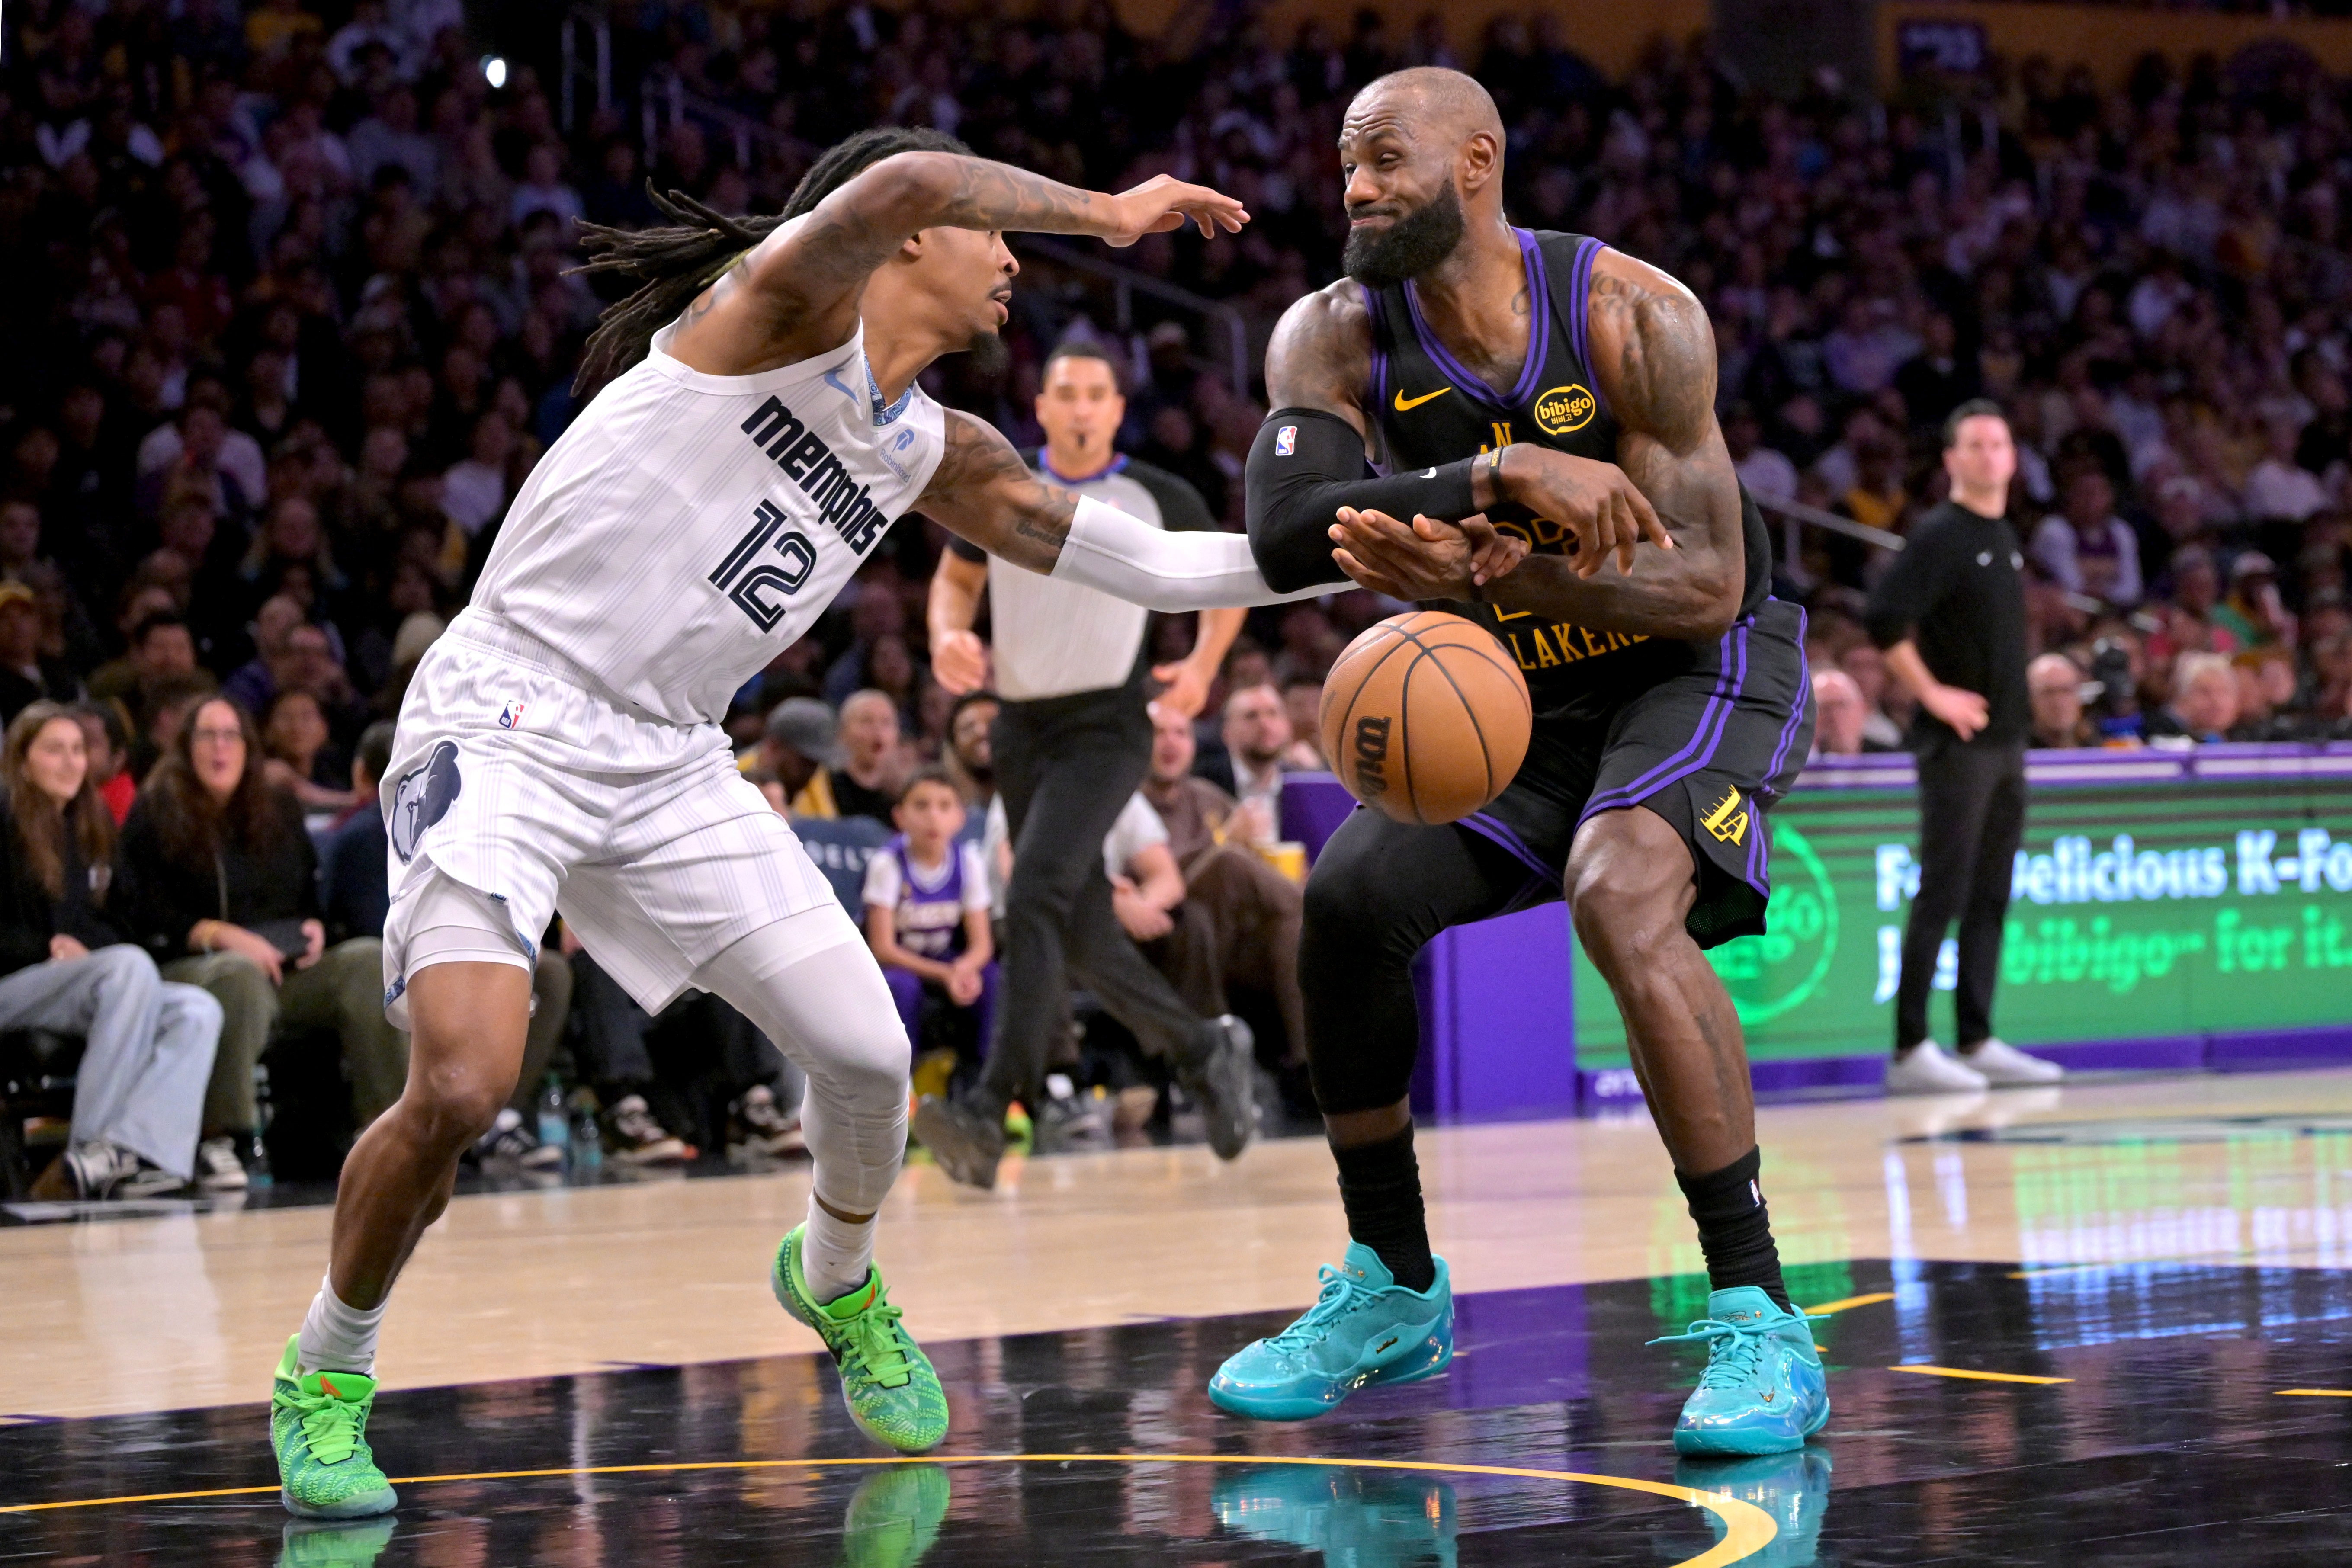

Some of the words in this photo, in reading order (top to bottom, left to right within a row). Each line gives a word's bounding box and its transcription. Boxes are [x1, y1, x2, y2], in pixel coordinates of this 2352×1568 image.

[1539, 398, 1591, 419] bibigo
[1551, 414, 1573, 424] 비비고
[740, 394, 889, 556] memphis
[880, 448, 911, 483] Robinhood
[707, 498, 817, 634] 12
[1508, 623, 1649, 670] LAKER
[500, 716, 510, 726] NBA
